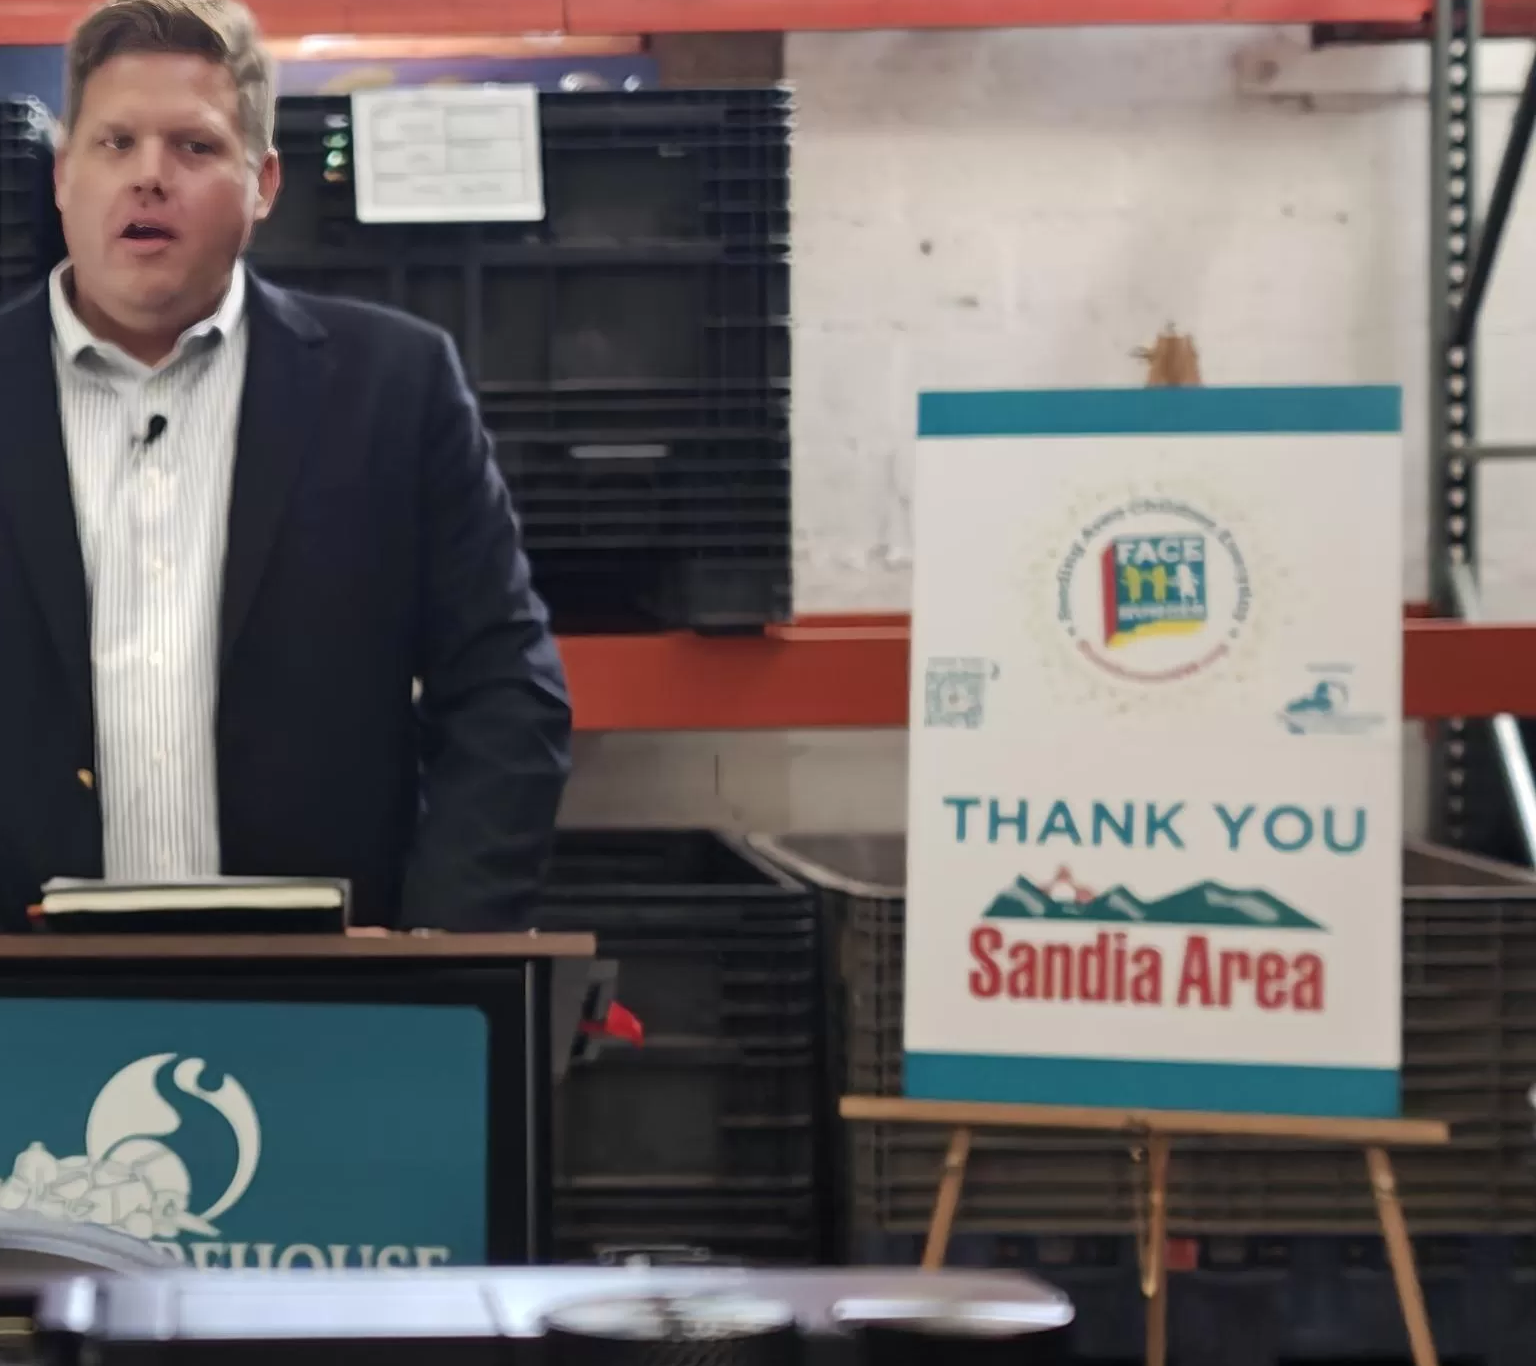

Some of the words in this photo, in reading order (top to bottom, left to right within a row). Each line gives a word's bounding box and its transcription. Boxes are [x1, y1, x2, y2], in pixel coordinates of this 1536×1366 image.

[1116, 539, 1204, 565] FACE
[942, 796, 1187, 851] THANK
[1214, 802, 1368, 855] YOU
[968, 925, 1162, 1007] Sandia
[1176, 933, 1326, 1013] Area
